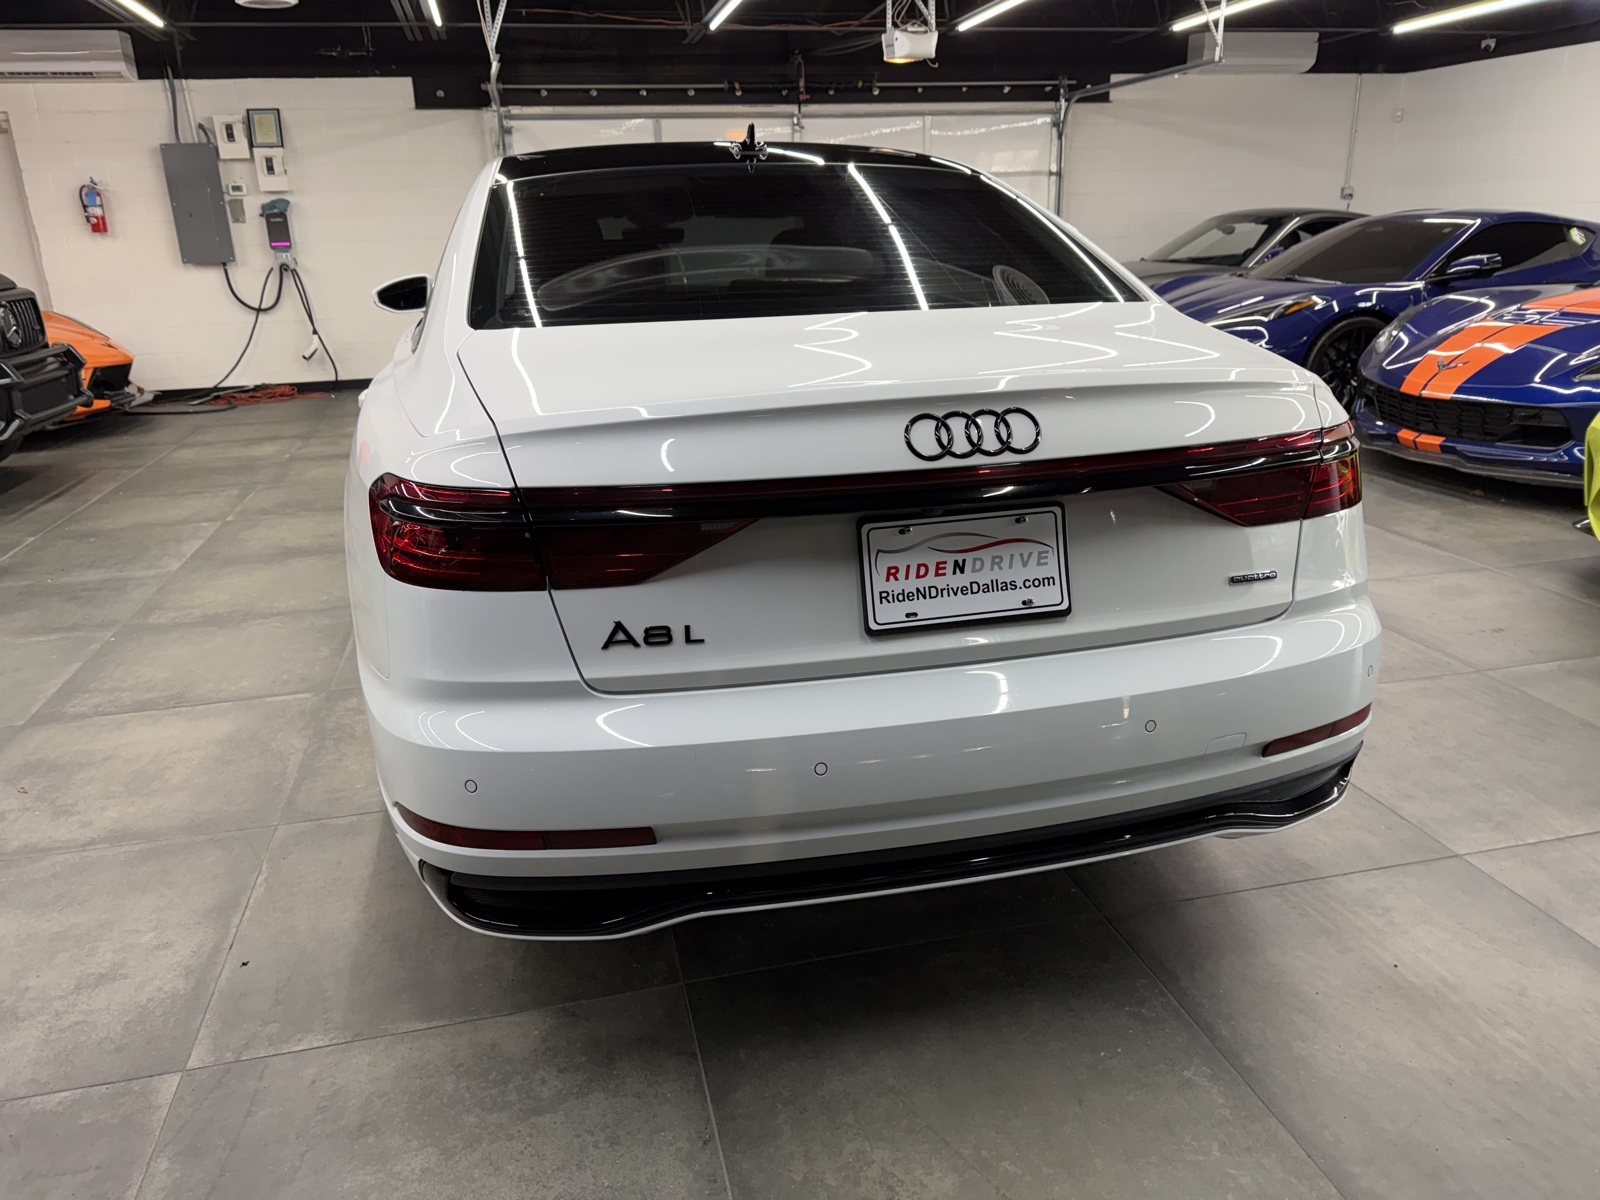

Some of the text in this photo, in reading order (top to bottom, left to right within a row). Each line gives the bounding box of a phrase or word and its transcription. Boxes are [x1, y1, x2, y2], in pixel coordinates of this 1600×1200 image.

[879, 576, 1056, 604] RideNDriveDallas.com
[600, 620, 706, 650] A8 L
